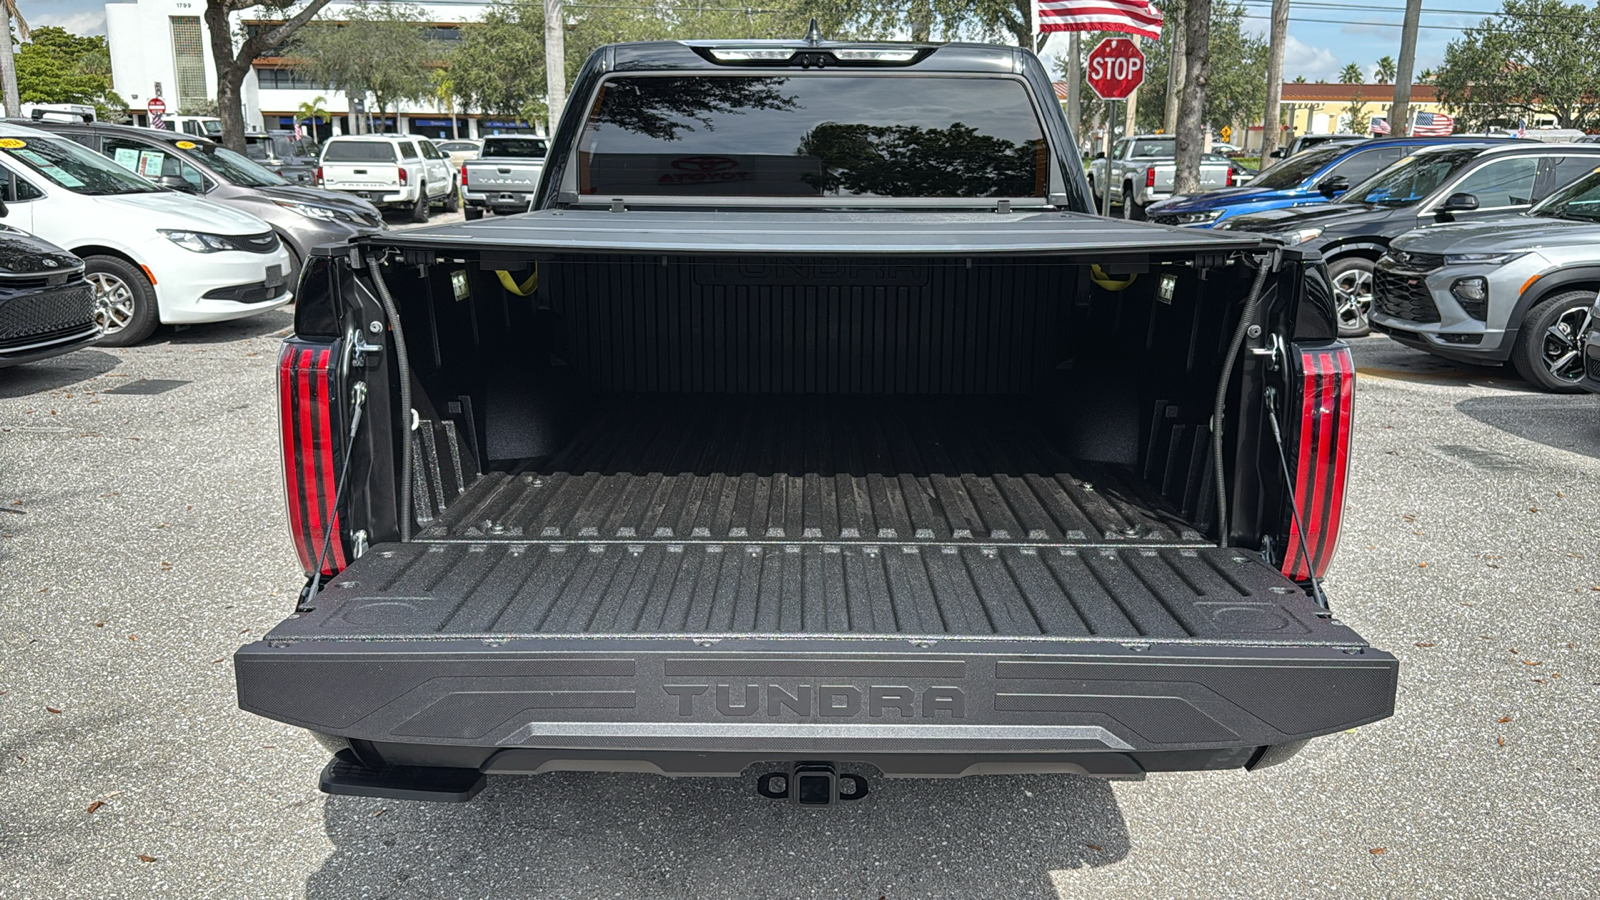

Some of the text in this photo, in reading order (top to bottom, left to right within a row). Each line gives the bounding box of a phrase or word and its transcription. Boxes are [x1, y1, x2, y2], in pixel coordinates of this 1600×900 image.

[1091, 57, 1141, 81] STOP
[699, 256, 922, 279] TUNDRA
[663, 684, 965, 718] TUNDRA
